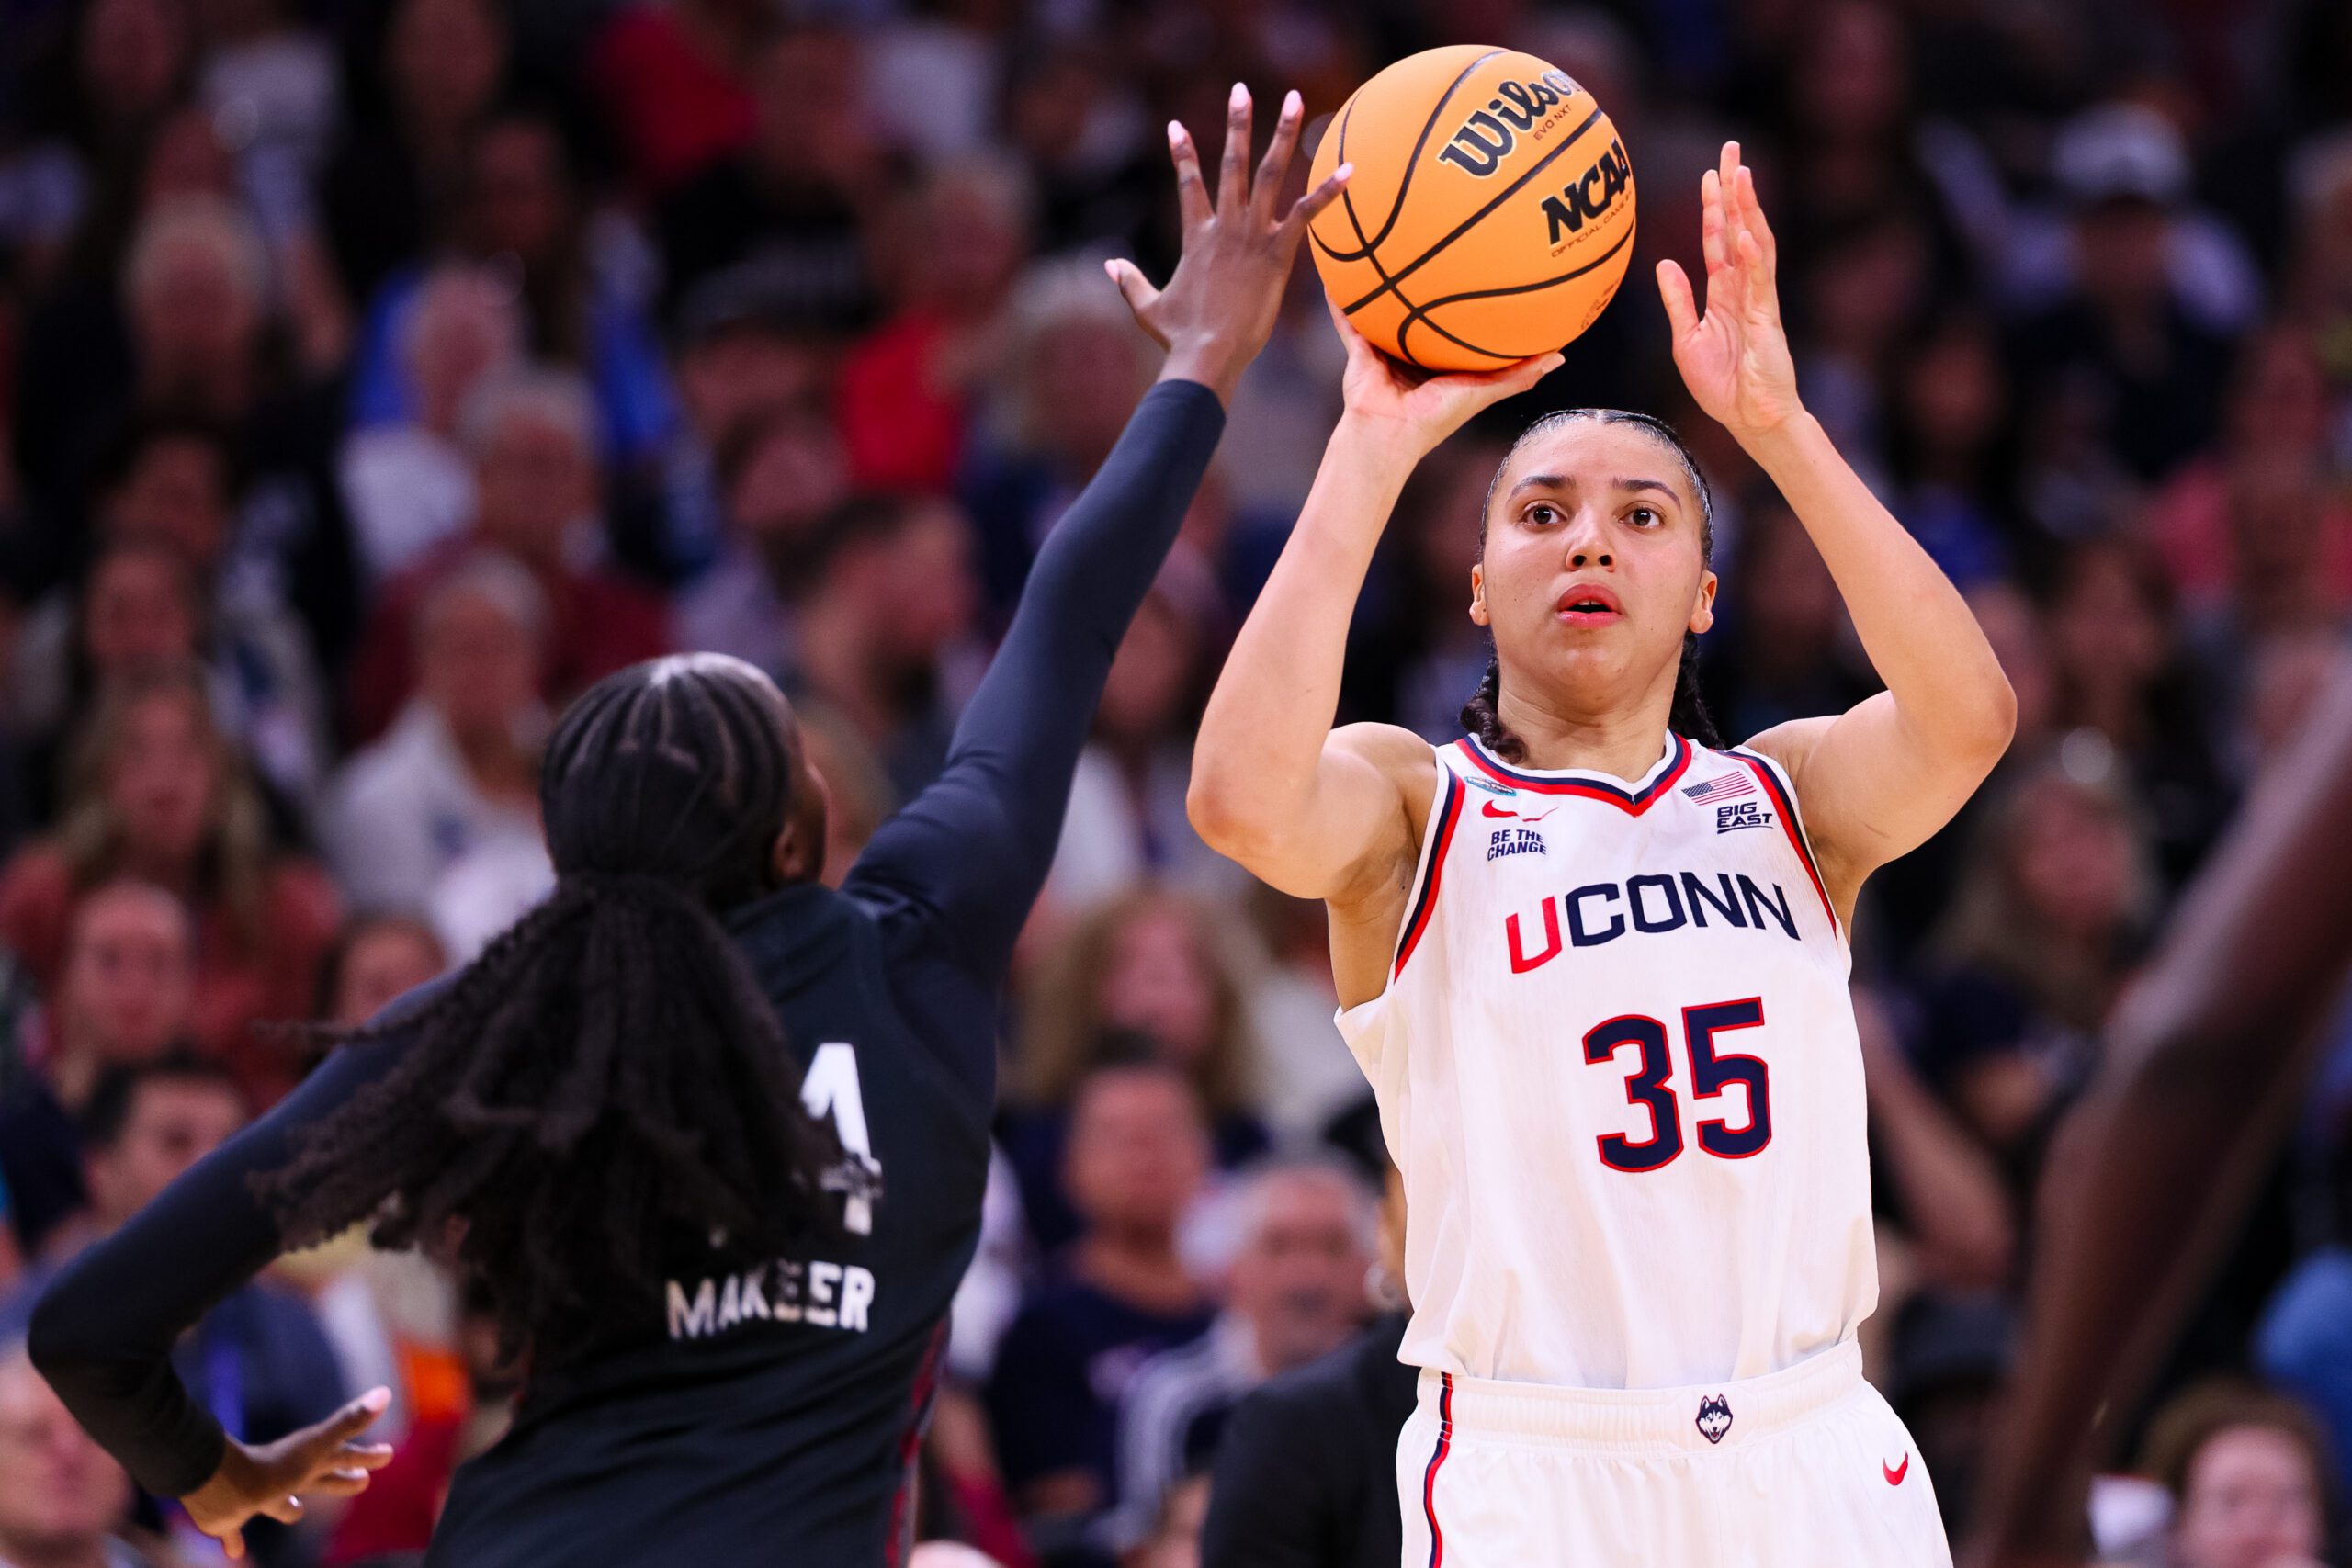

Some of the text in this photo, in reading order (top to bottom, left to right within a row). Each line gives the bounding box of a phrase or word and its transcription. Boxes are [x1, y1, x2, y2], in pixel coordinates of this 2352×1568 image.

[1437, 69, 1581, 180] Wilso
[1532, 103, 1573, 141] EVO NXT
[1541, 137, 1631, 246] NCAA
[1551, 225, 1602, 258] OFFICIAL
[1716, 801, 1758, 818] BIG
[1716, 813, 1773, 829] EAST
[1487, 840, 1547, 862] CHANGE
[1490, 829, 1544, 846] BE THE
[1505, 871, 1801, 974] UCONN
[1581, 996, 1772, 1173] 35
